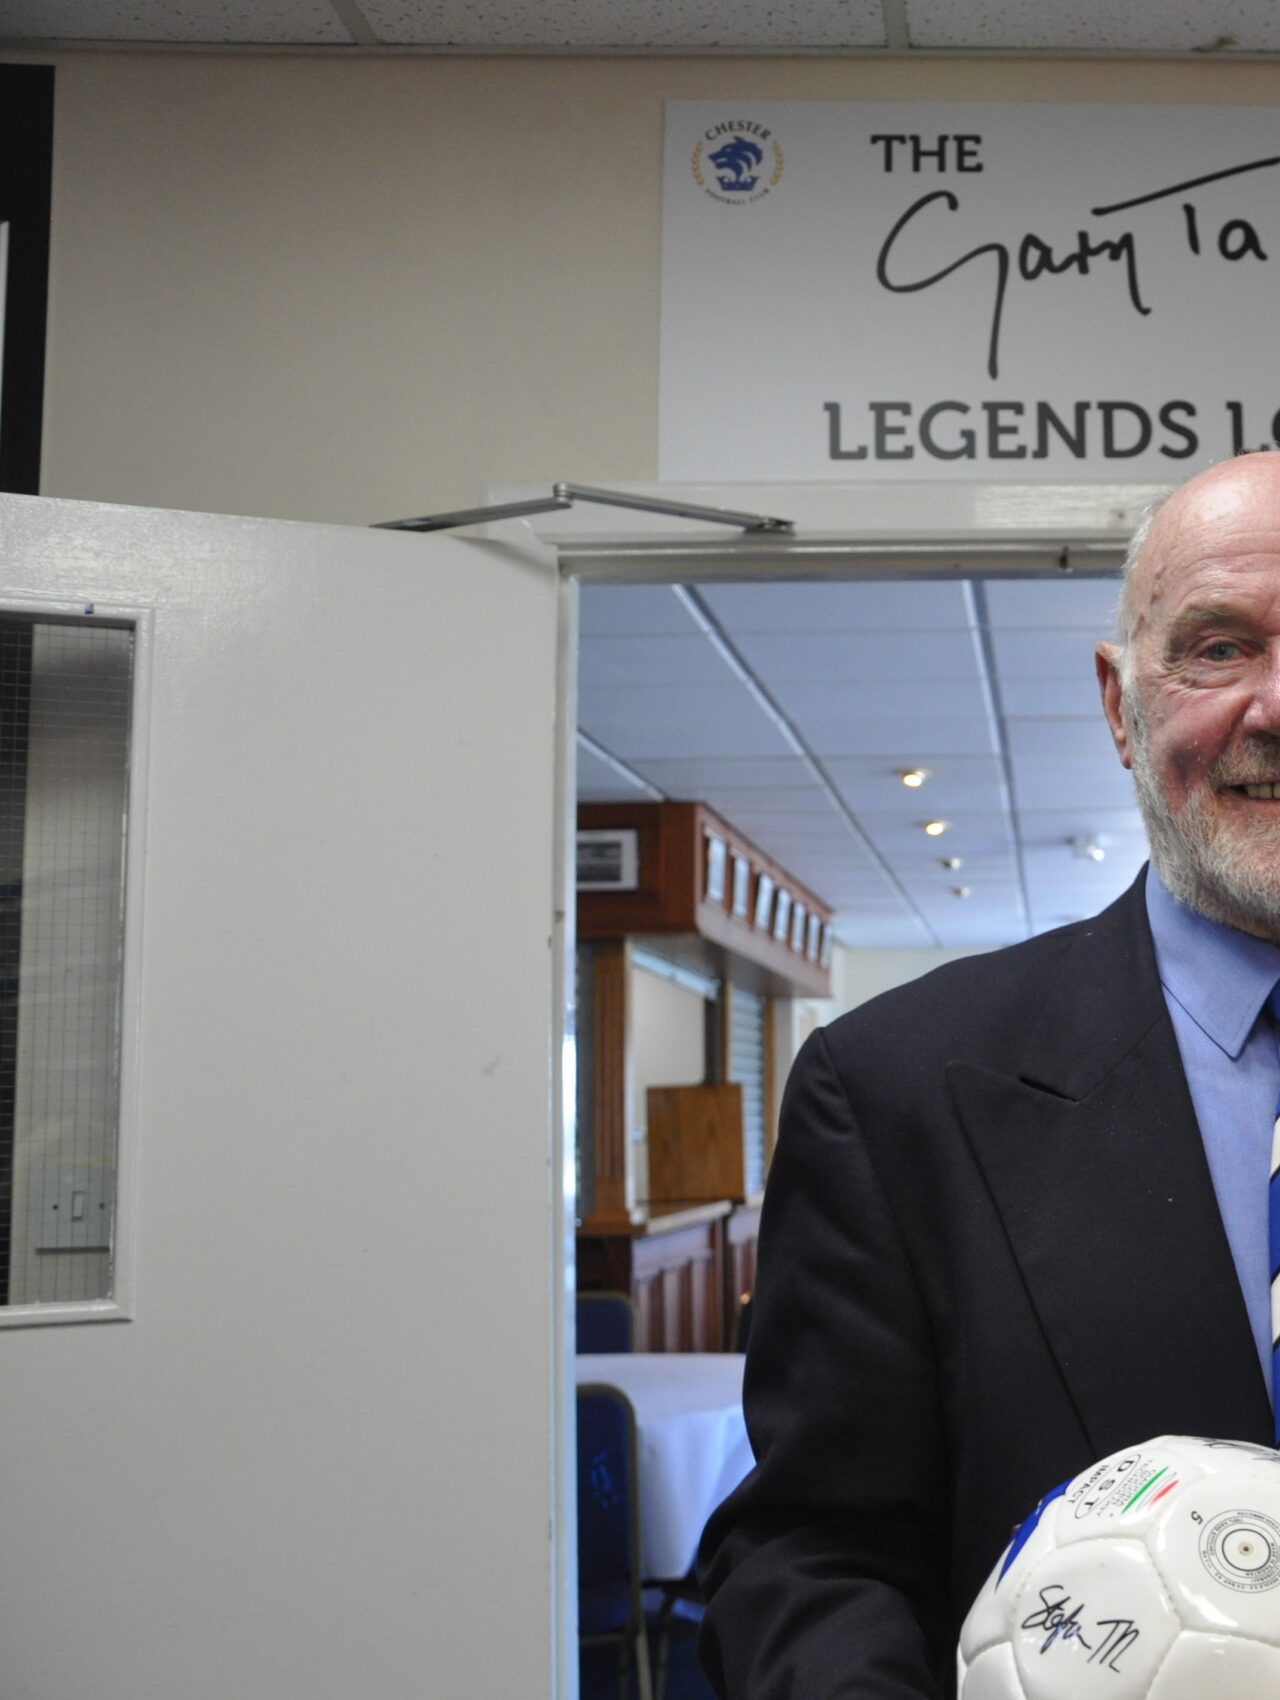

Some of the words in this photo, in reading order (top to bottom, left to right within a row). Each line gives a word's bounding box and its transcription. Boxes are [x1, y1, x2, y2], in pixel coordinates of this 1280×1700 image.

[705, 120, 771, 141] CHESTER
[871, 134, 984, 173] THE
[823, 401, 1199, 460] LEGENDS
[1067, 1465, 1109, 1504] IMPACT
